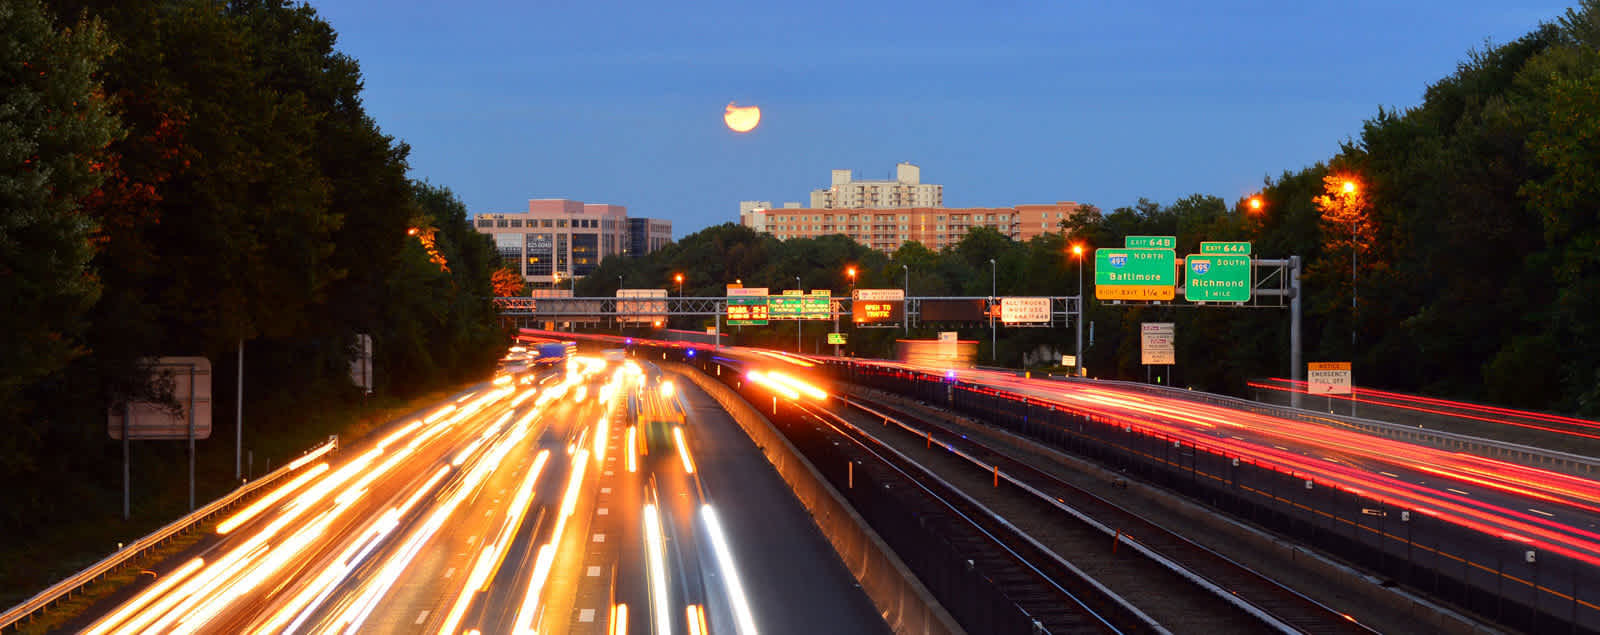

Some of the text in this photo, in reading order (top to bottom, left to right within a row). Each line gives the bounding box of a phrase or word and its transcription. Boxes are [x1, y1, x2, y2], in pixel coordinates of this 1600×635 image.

[1111, 256, 1126, 265] 495
[1193, 264, 1209, 272] 495
[1110, 272, 1160, 280] Baltimore
[1192, 279, 1244, 287] Richmond
